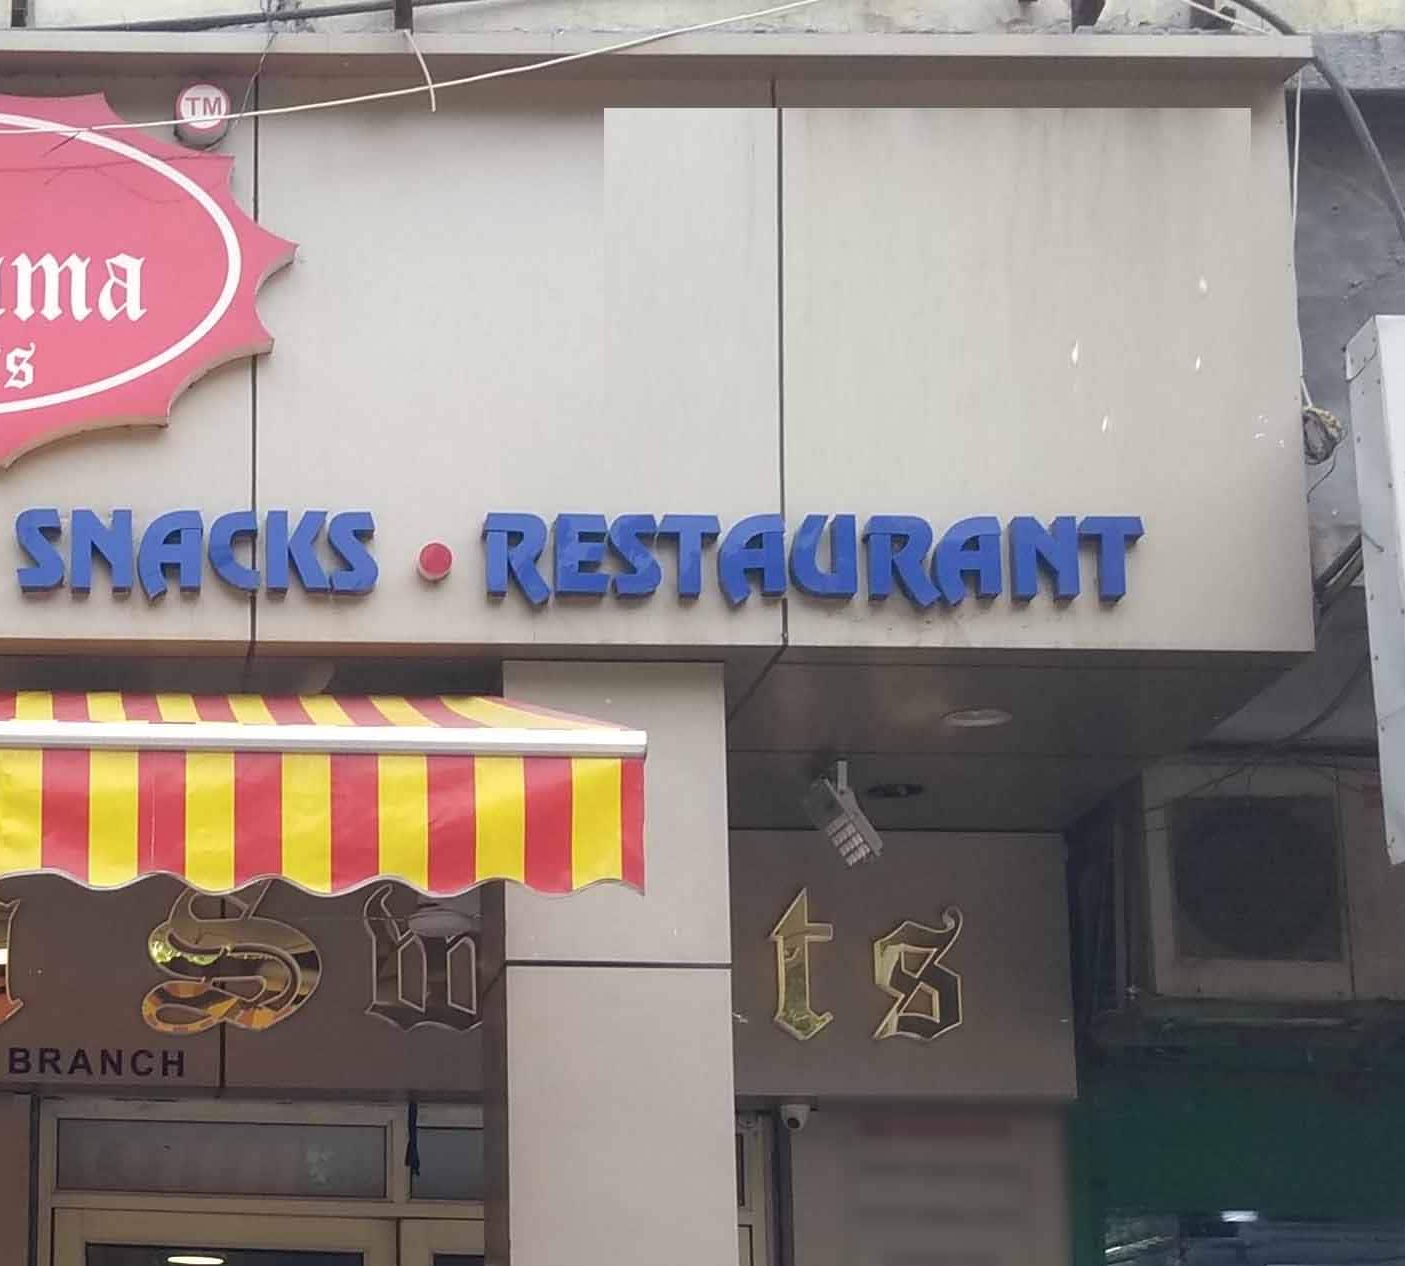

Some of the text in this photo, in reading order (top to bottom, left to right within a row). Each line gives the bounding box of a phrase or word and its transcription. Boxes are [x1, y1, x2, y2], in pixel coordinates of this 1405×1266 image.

[185, 97, 222, 116] TM
[14, 507, 380, 600] SNACKS
[483, 511, 1145, 608] RESTAURANT
[8, 1047, 186, 1078] BRANCH
